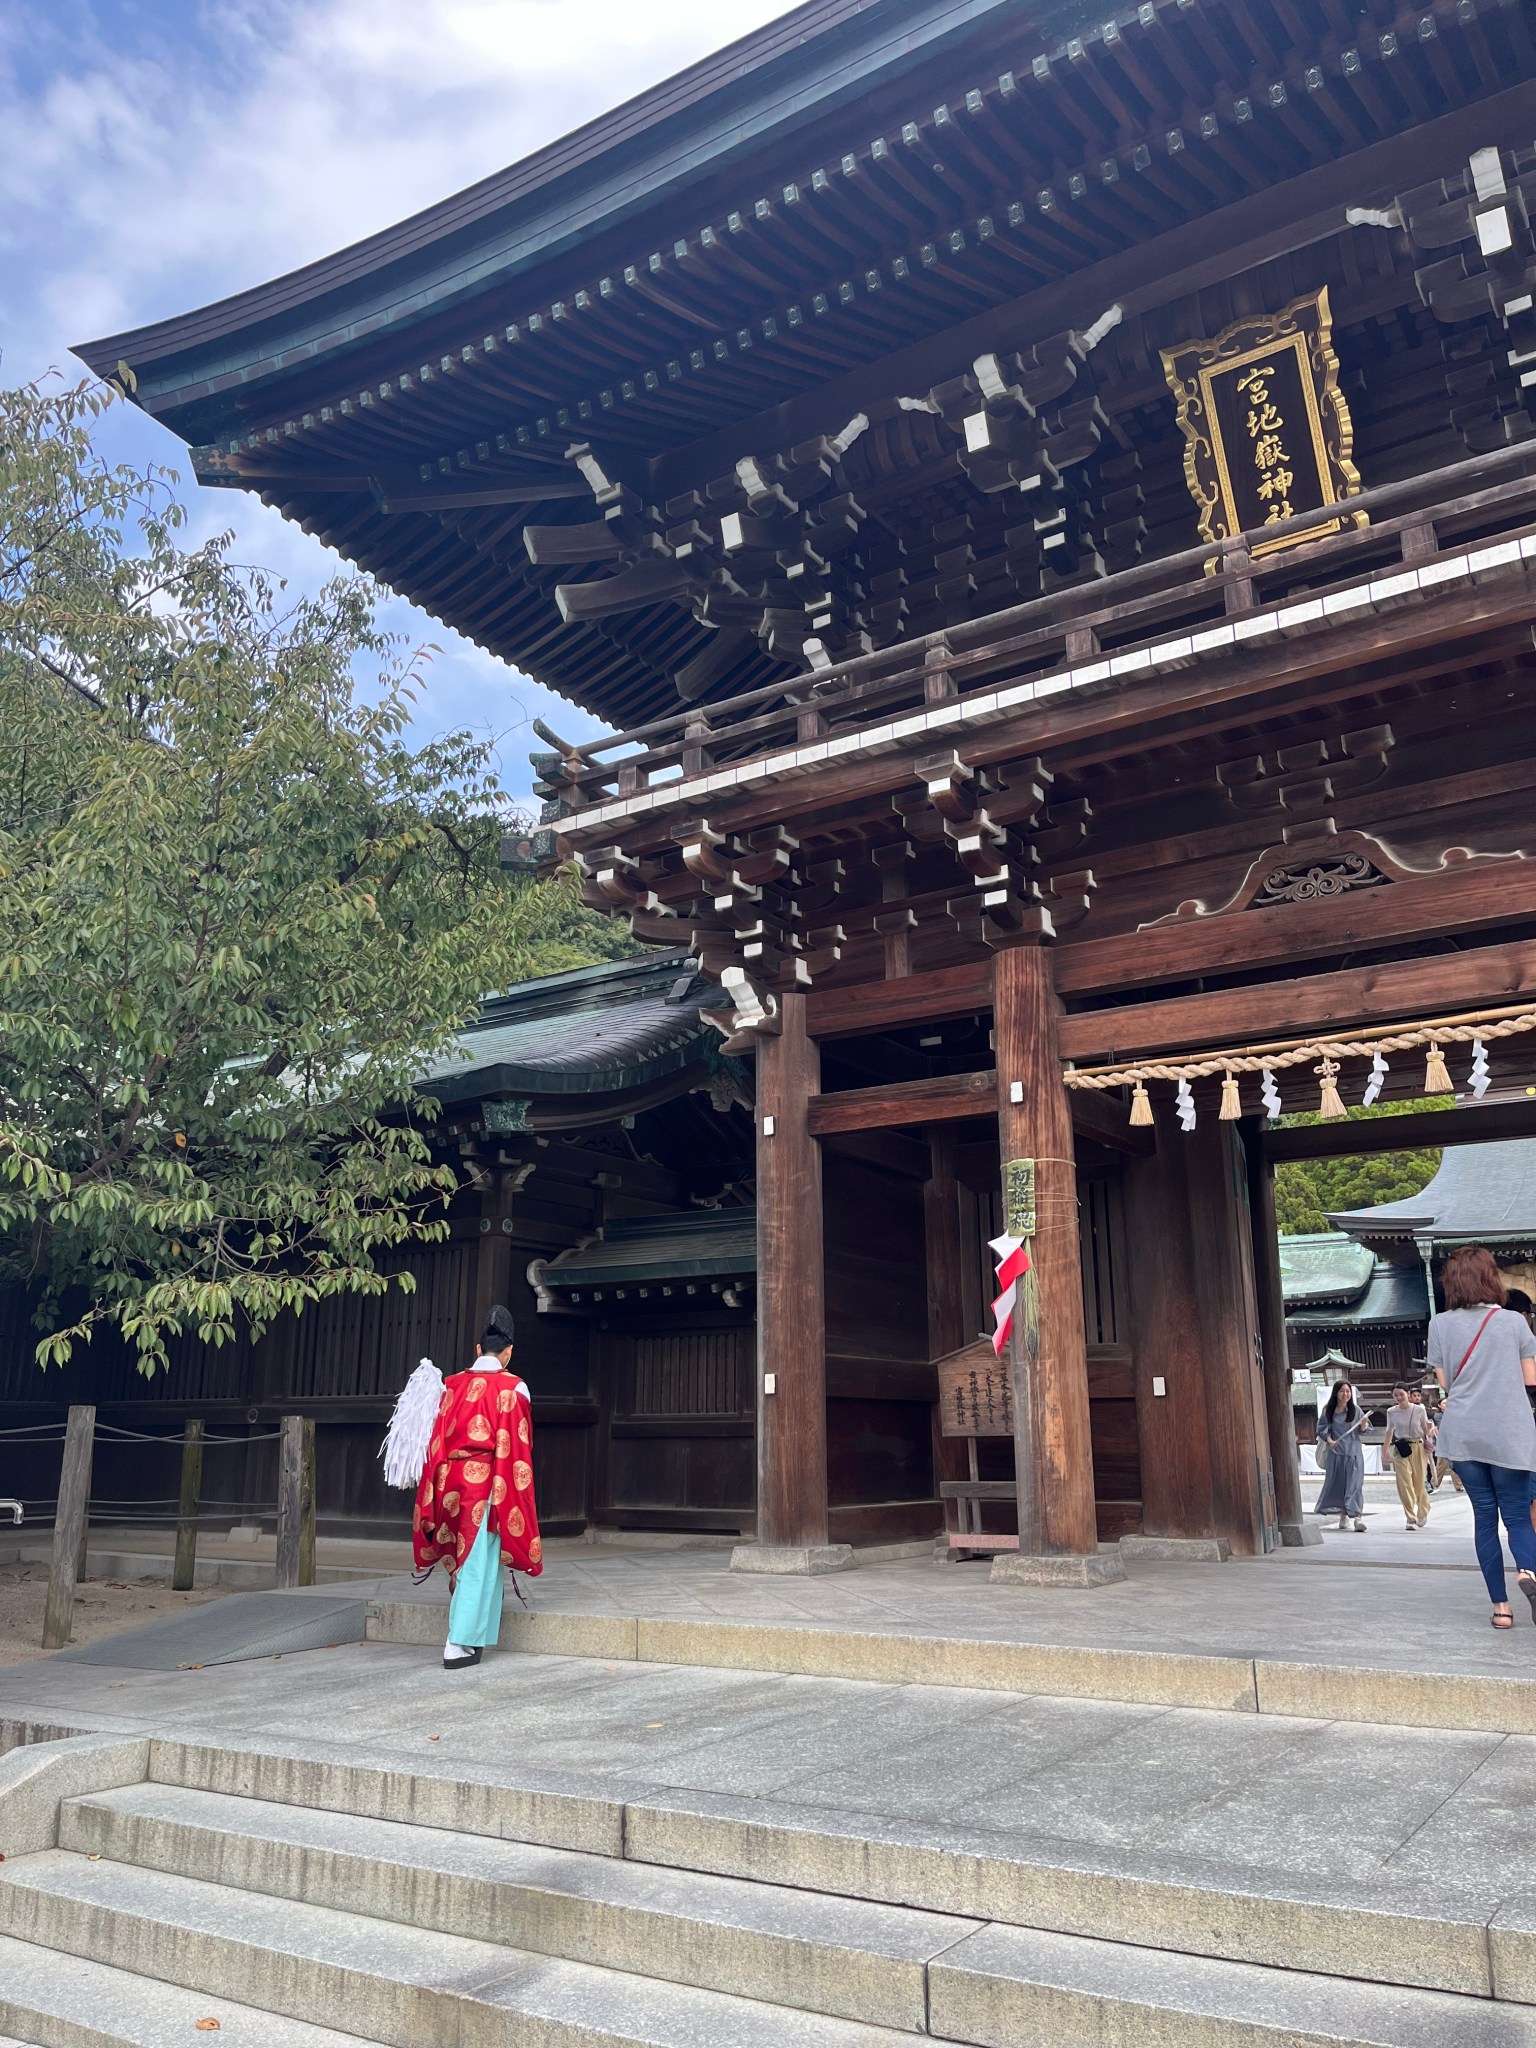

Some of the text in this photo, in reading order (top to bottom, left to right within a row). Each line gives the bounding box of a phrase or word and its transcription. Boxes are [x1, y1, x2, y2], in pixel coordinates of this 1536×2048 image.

[1237, 366, 1297, 526] 宮地嶽神社
[1010, 1166, 1034, 1231] 初稲穂
